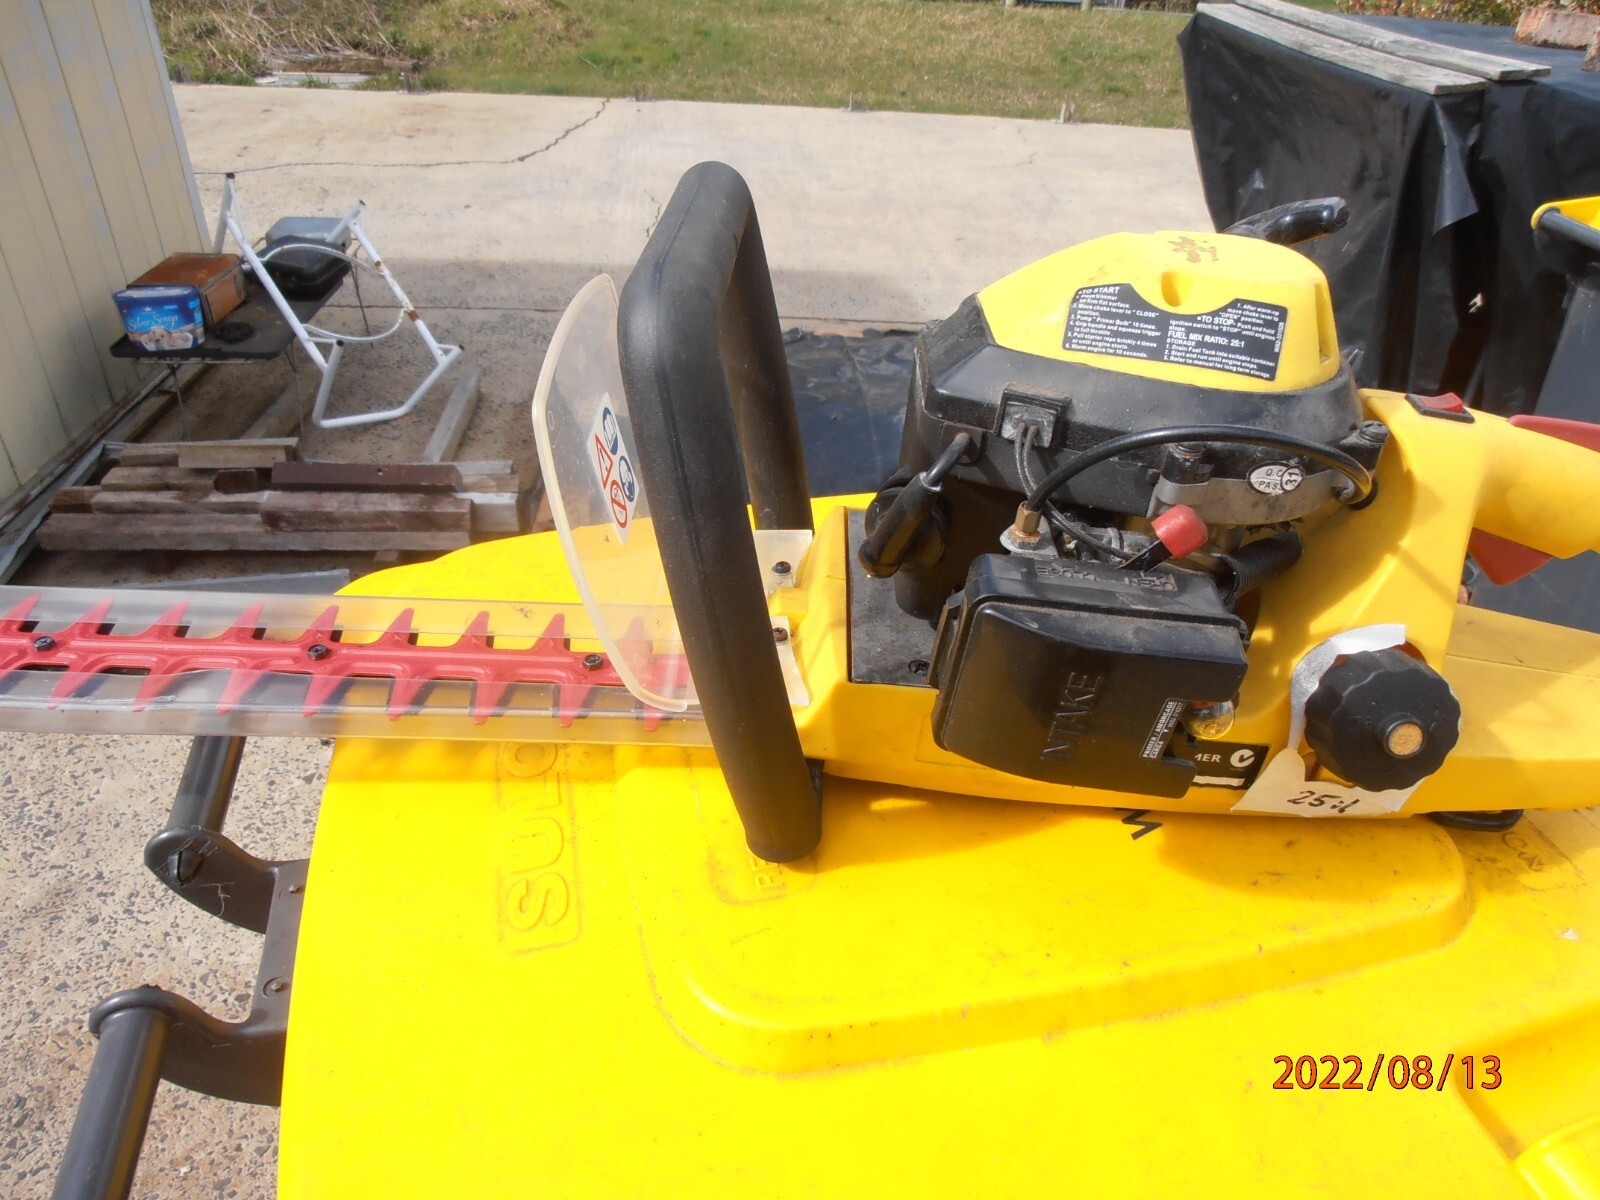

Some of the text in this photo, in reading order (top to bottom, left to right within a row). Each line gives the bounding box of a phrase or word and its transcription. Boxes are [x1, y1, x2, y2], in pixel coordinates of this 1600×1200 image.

[1093, 286, 1120, 294] START
[1257, 308, 1280, 316] warm-up
[1142, 328, 1162, 336] trigger
[1262, 327, 1276, 335] hold
[1168, 330, 1245, 348] FUEL MIX RATIO: 25:1
[1254, 332, 1276, 340] engines
[1116, 337, 1136, 346] briskly
[1166, 338, 1196, 346] STORAGE
[1228, 353, 1250, 362] suitable
[1224, 364, 1237, 372] long
[1284, 471, 1300, 487] 31
[1040, 672, 1102, 763] INTAKE
